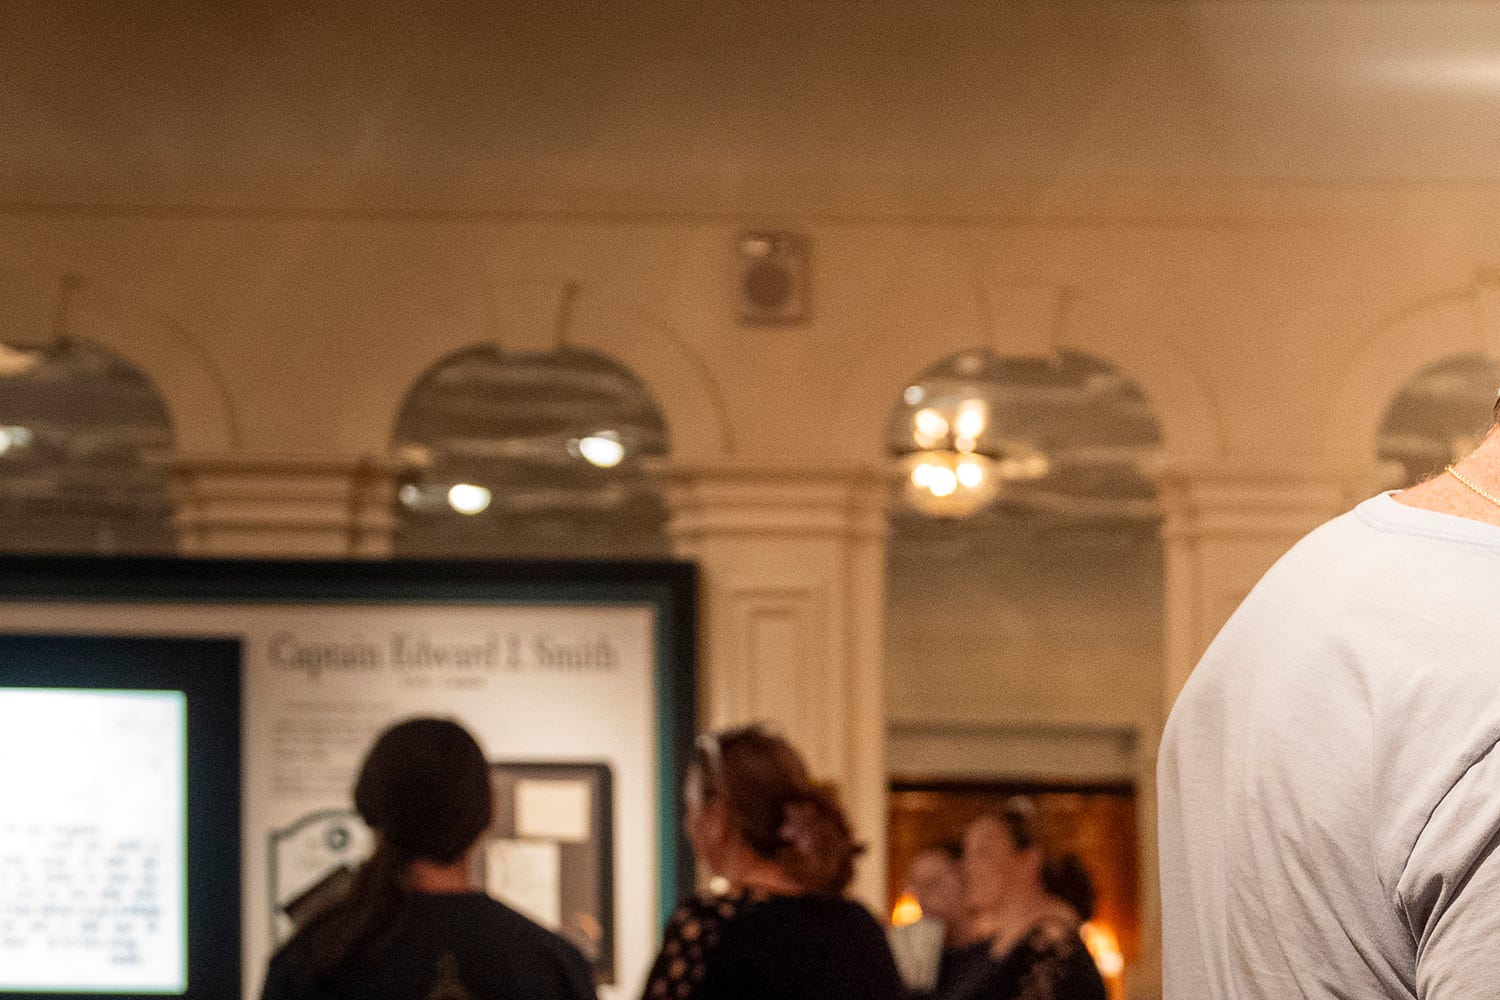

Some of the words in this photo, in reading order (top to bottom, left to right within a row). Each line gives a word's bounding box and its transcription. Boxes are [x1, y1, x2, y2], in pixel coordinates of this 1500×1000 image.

[268, 630, 382, 683] Captain
[391, 631, 498, 672] Edward
[532, 631, 619, 671] Smith
